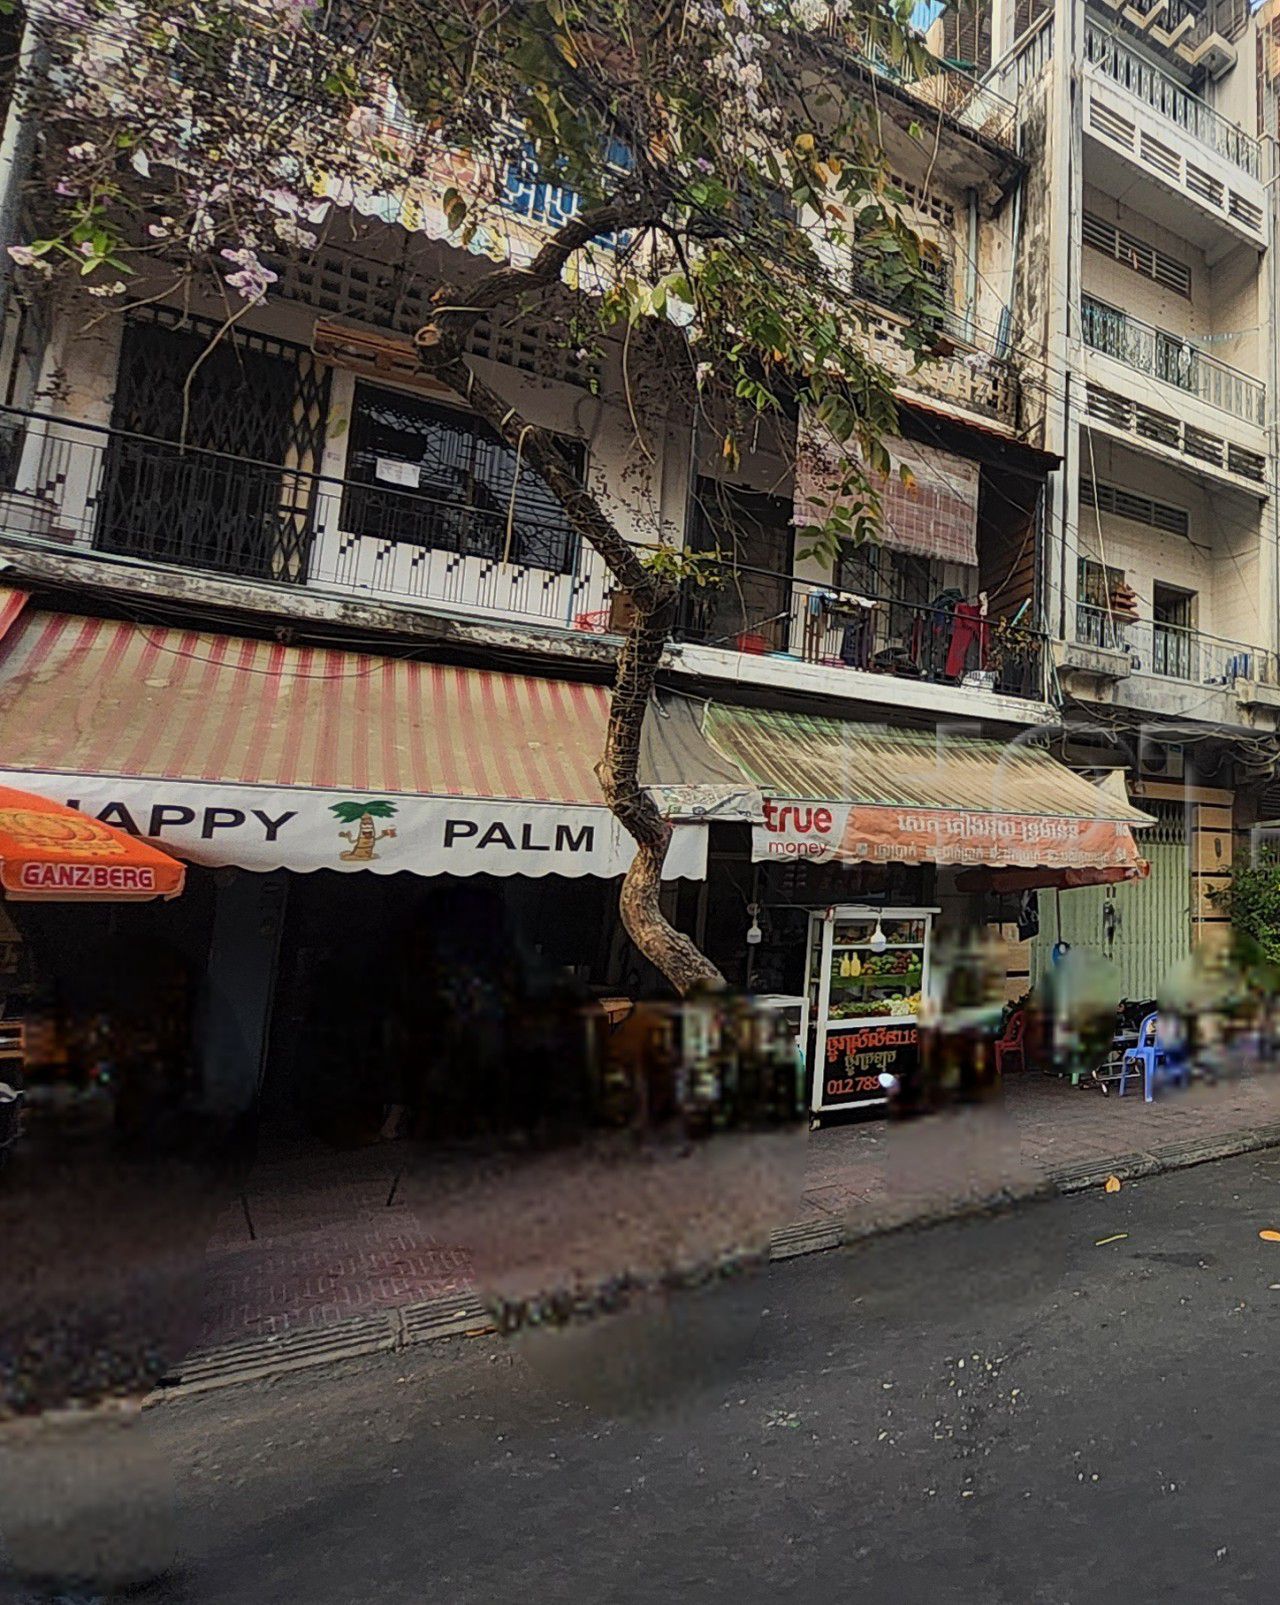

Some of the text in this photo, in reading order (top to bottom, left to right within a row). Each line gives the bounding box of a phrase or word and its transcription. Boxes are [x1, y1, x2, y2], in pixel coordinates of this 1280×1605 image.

[66, 799, 595, 853] APPY PALM
[762, 798, 833, 834] true
[768, 841, 828, 858] money
[23, 863, 154, 889] GANZBERG
[827, 1078, 854, 1095] 012
